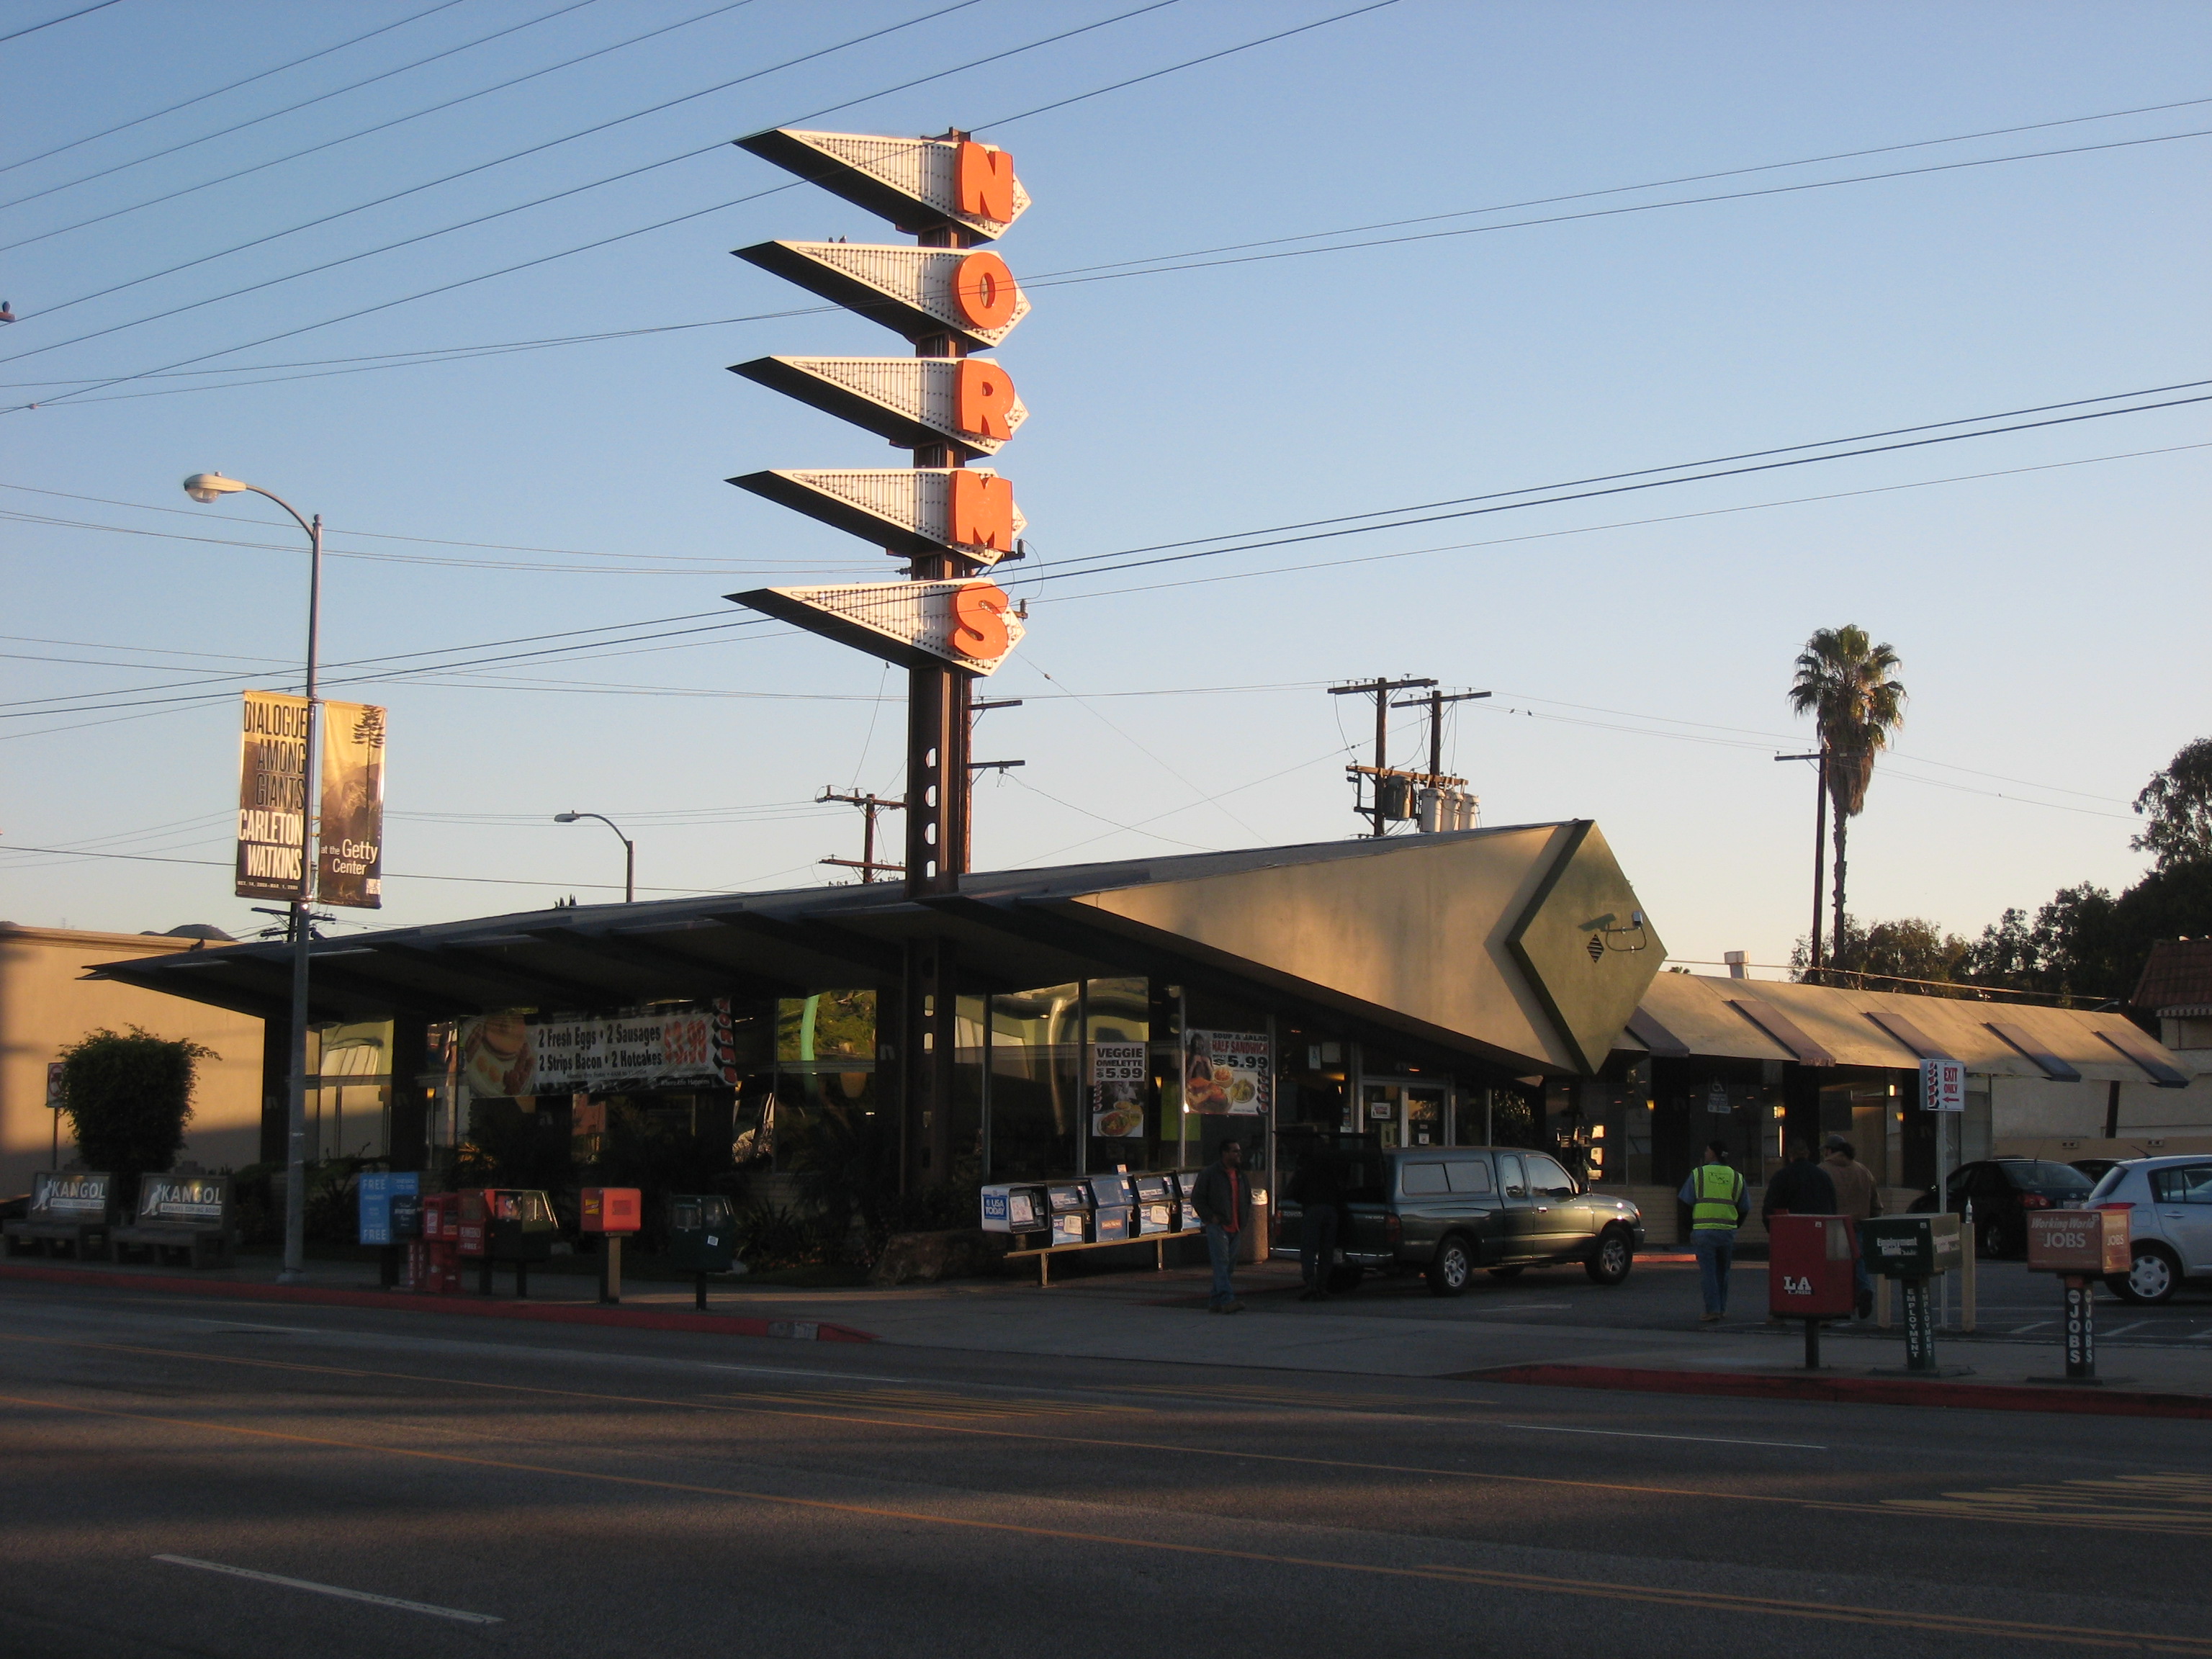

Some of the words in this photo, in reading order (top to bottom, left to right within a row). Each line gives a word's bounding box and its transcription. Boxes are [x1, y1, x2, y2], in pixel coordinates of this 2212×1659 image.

[947, 140, 1017, 660] NORMS
[243, 701, 307, 738] DIALOGUE
[257, 738, 306, 774] AMONG
[256, 774, 305, 809] GIANTS
[238, 809, 304, 845] CARLETON
[320, 845, 327, 854] at
[328, 845, 340, 855] the
[342, 839, 378, 863] Getty
[247, 845, 302, 881] WATKINS
[333, 858, 367, 876] Center
[539, 1029, 544, 1048] 2
[547, 1028, 572, 1047] Fresh
[575, 1027, 596, 1050] Eggs
[607, 1024, 613, 1043] 2
[616, 1023, 661, 1046] Sausages
[1097, 1048, 1143, 1058] VEGGIE
[1213, 1040, 1229, 1052] HALF
[1231, 1041, 1268, 1055] SANDWICH
[539, 1054, 544, 1071] 2
[547, 1054, 572, 1074] Strips
[575, 1053, 601, 1070] Bacon
[612, 1051, 618, 1067] 2
[620, 1049, 662, 1067] Hotcakes
[1096, 1068, 1143, 1078] $5.99
[1944, 1067, 1958, 1082] EXIT
[1944, 1084, 1958, 1094] ONLY
[51, 1180, 106, 1199] KANGOL
[161, 1184, 222, 1204] KANGOL
[363, 1179, 386, 1190] FREE
[986, 1206, 1004, 1215] TODAY
[2031, 1218, 2068, 1231] Working
[2069, 1217, 2095, 1228] World
[364, 1228, 387, 1240] FREE
[2044, 1232, 2086, 1248] JOBS
[2107, 1234, 2124, 1246] JOBS
[1907, 1288, 1919, 1358] EMPLOYMENT
[1923, 1287, 1932, 1357] EMPLOYMENT
[2068, 1305, 2081, 1364] JOBS
